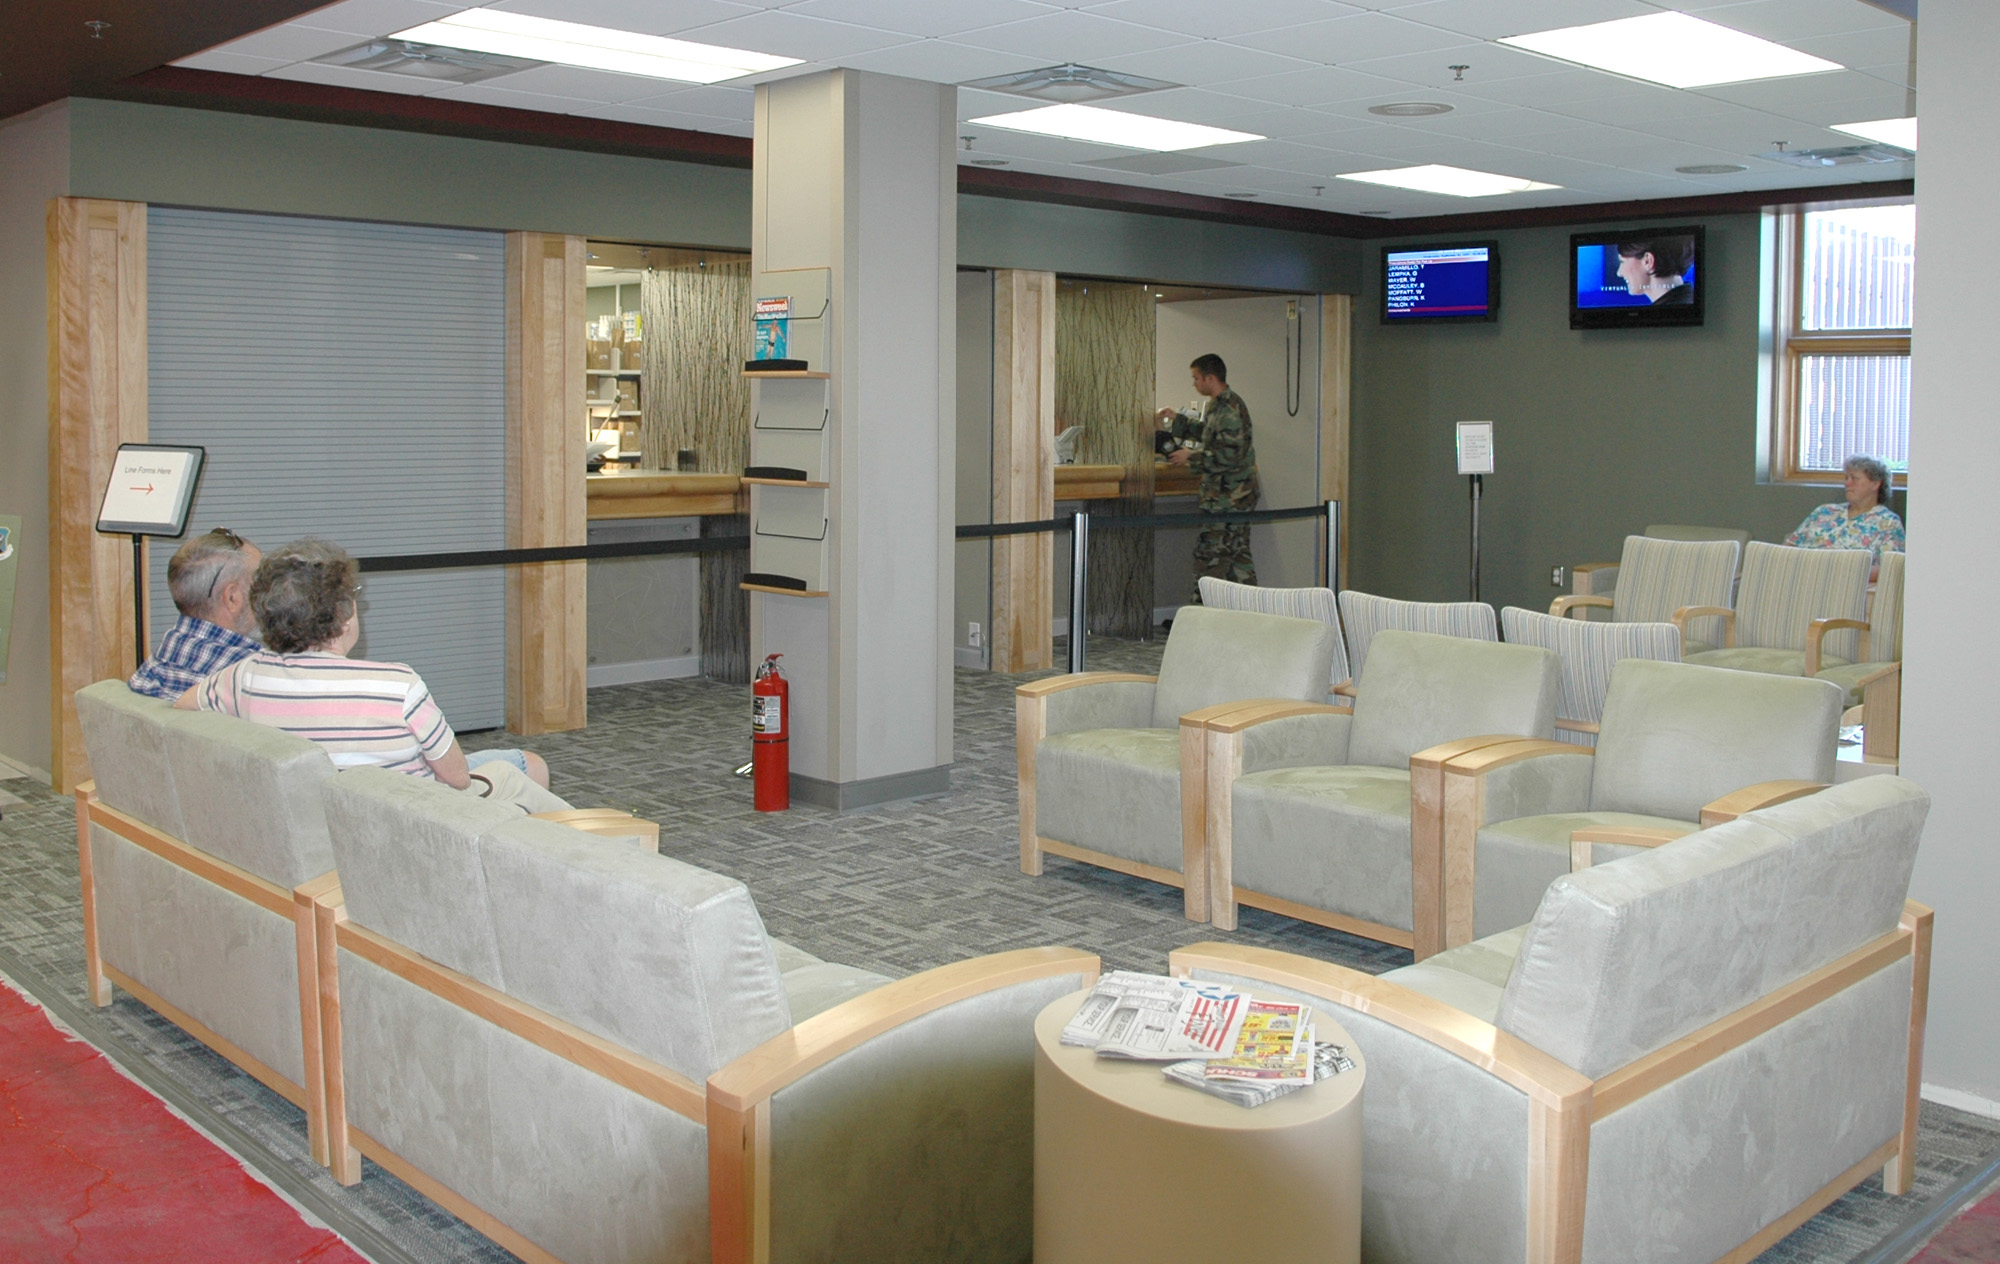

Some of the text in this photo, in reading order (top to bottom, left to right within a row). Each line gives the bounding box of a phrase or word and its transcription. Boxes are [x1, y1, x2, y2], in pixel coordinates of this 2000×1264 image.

[124, 465, 172, 475] Line Forms Here
